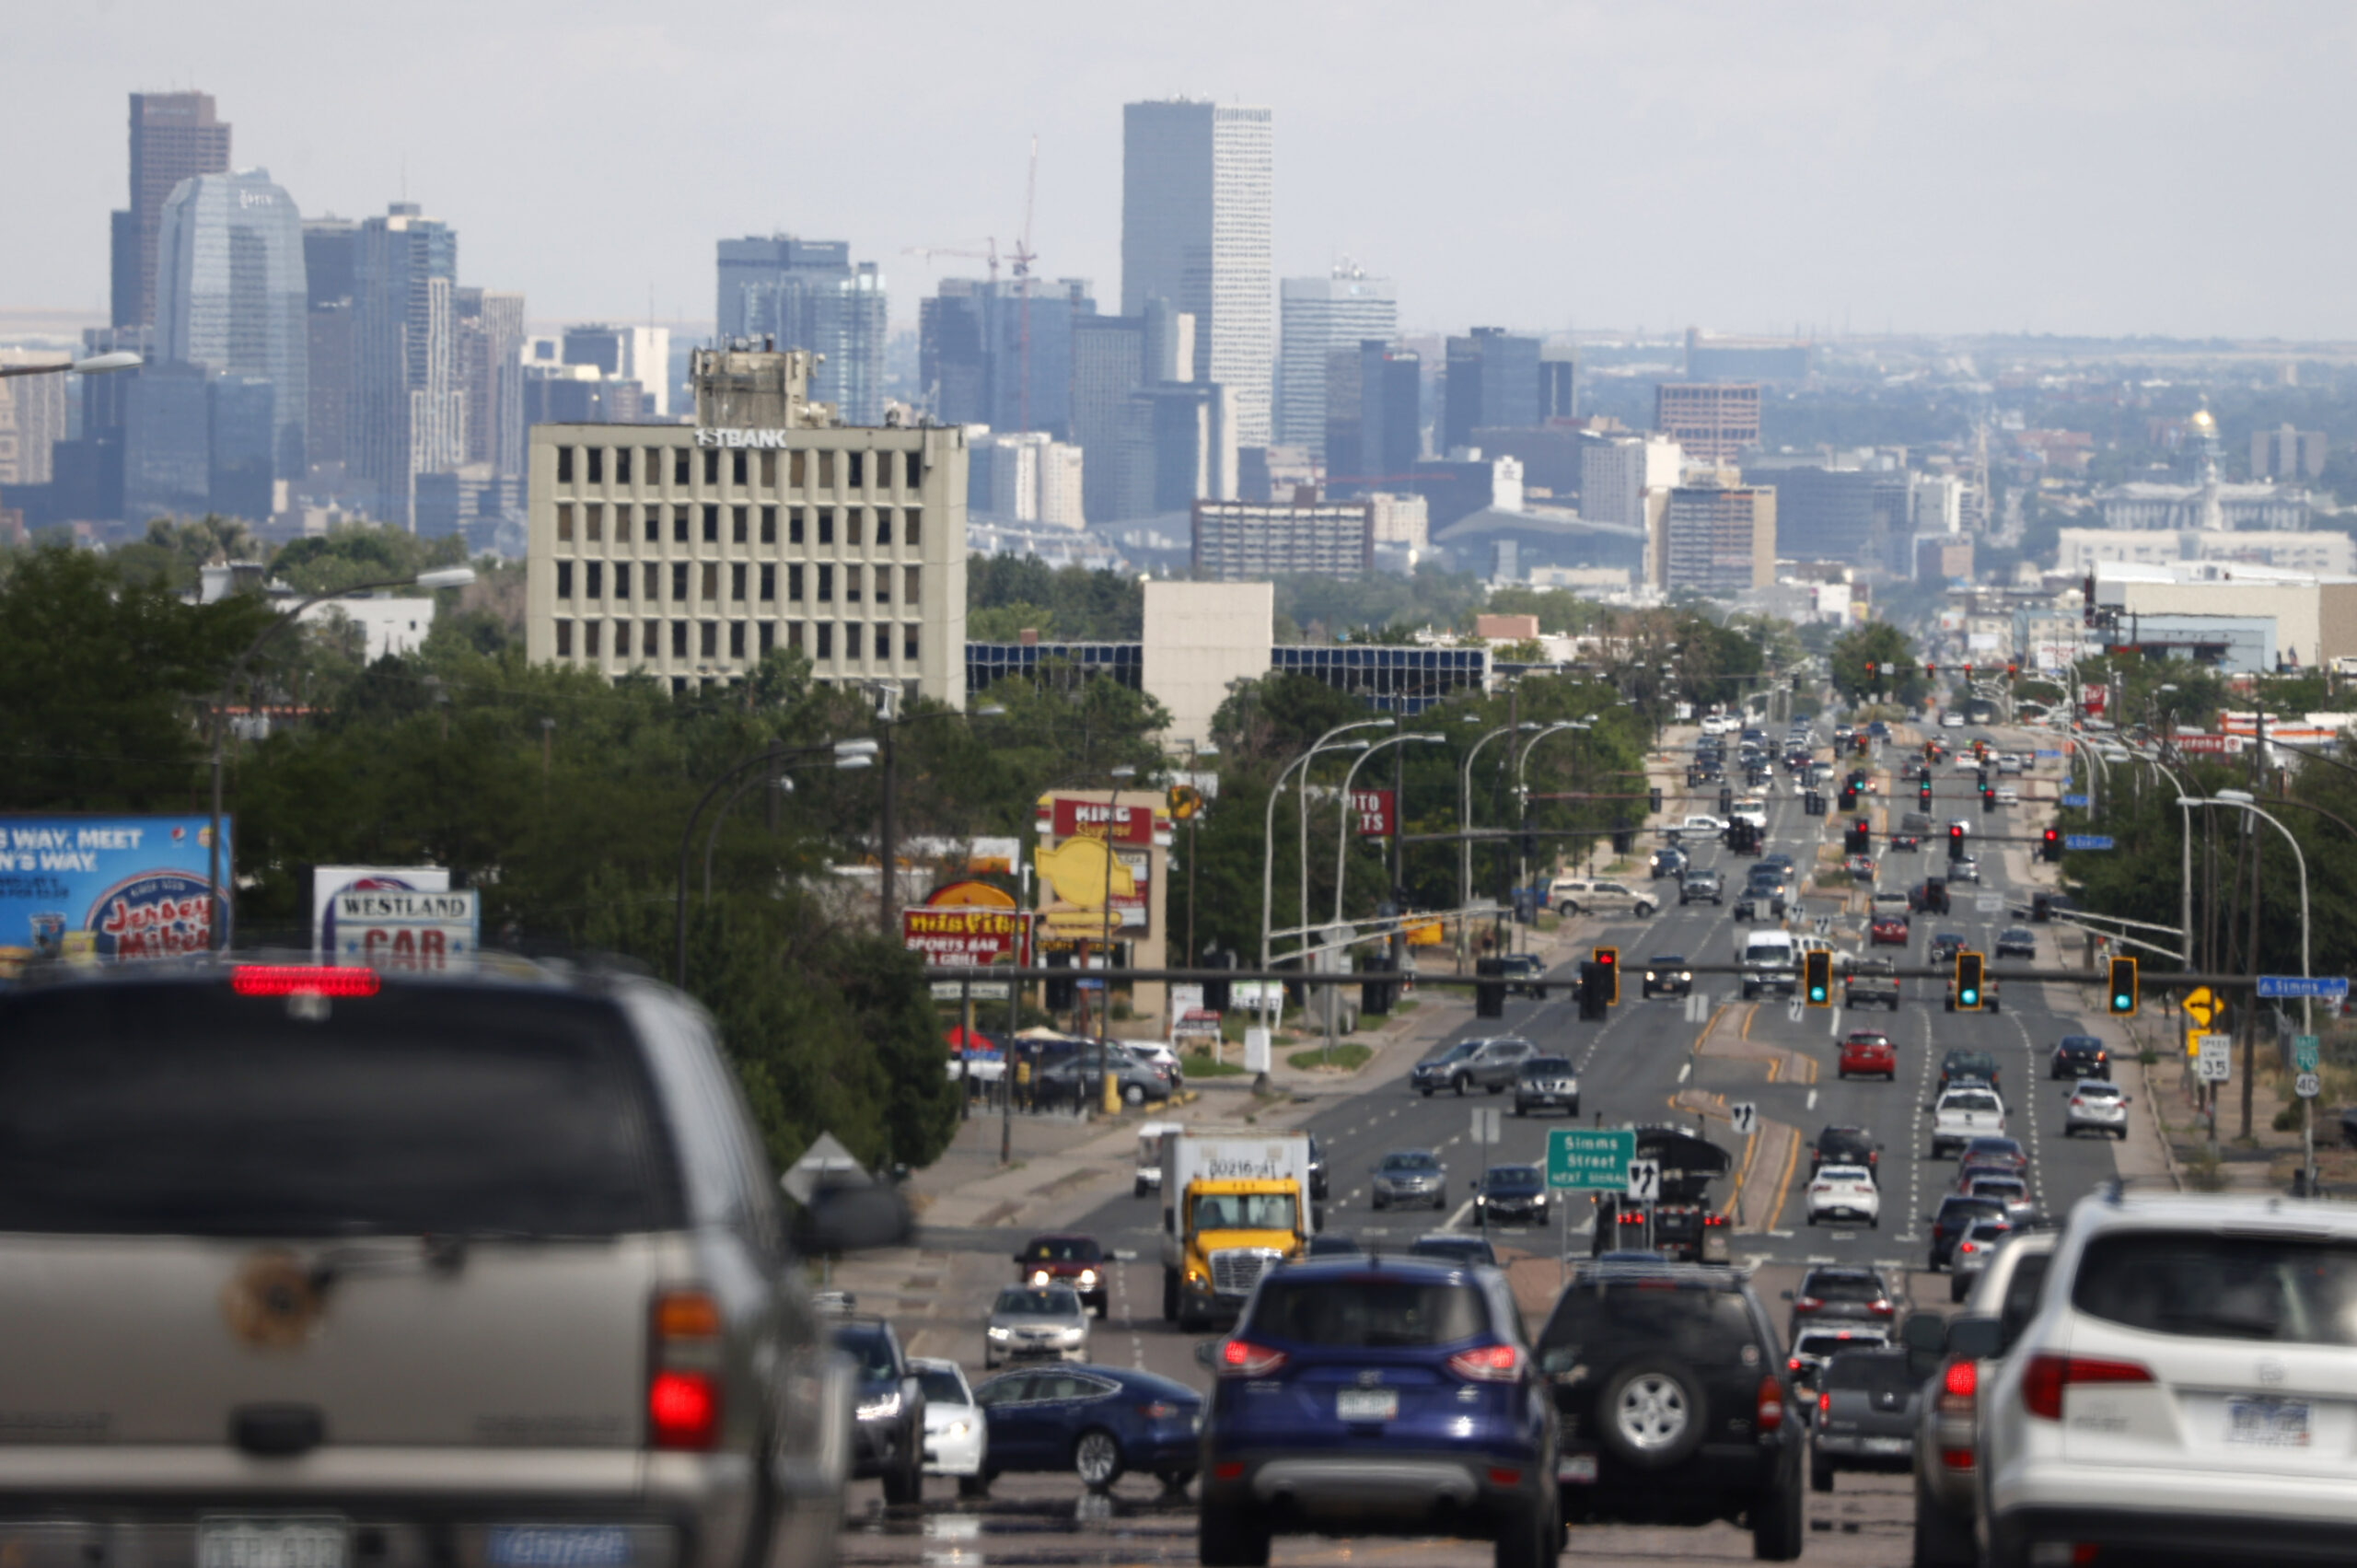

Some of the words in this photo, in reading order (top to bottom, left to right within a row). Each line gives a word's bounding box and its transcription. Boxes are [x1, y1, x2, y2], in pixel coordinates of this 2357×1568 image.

[77, 829, 142, 849] MEET
[103, 895, 213, 934] Jersey
[344, 897, 466, 917] WESTLAND
[364, 928, 447, 970] CAR
[906, 935, 965, 952] SPORTS
[968, 937, 999, 952] BAR
[939, 952, 979, 968] GRILL
[2200, 1038, 2227, 1047] SPEED
[2202, 1060, 2227, 1076] 35
[2297, 1079, 2318, 1093] 40
[1565, 1135, 1619, 1150] Simms
[1568, 1153, 1616, 1168] Street
[1551, 1171, 1582, 1183] NEXT
